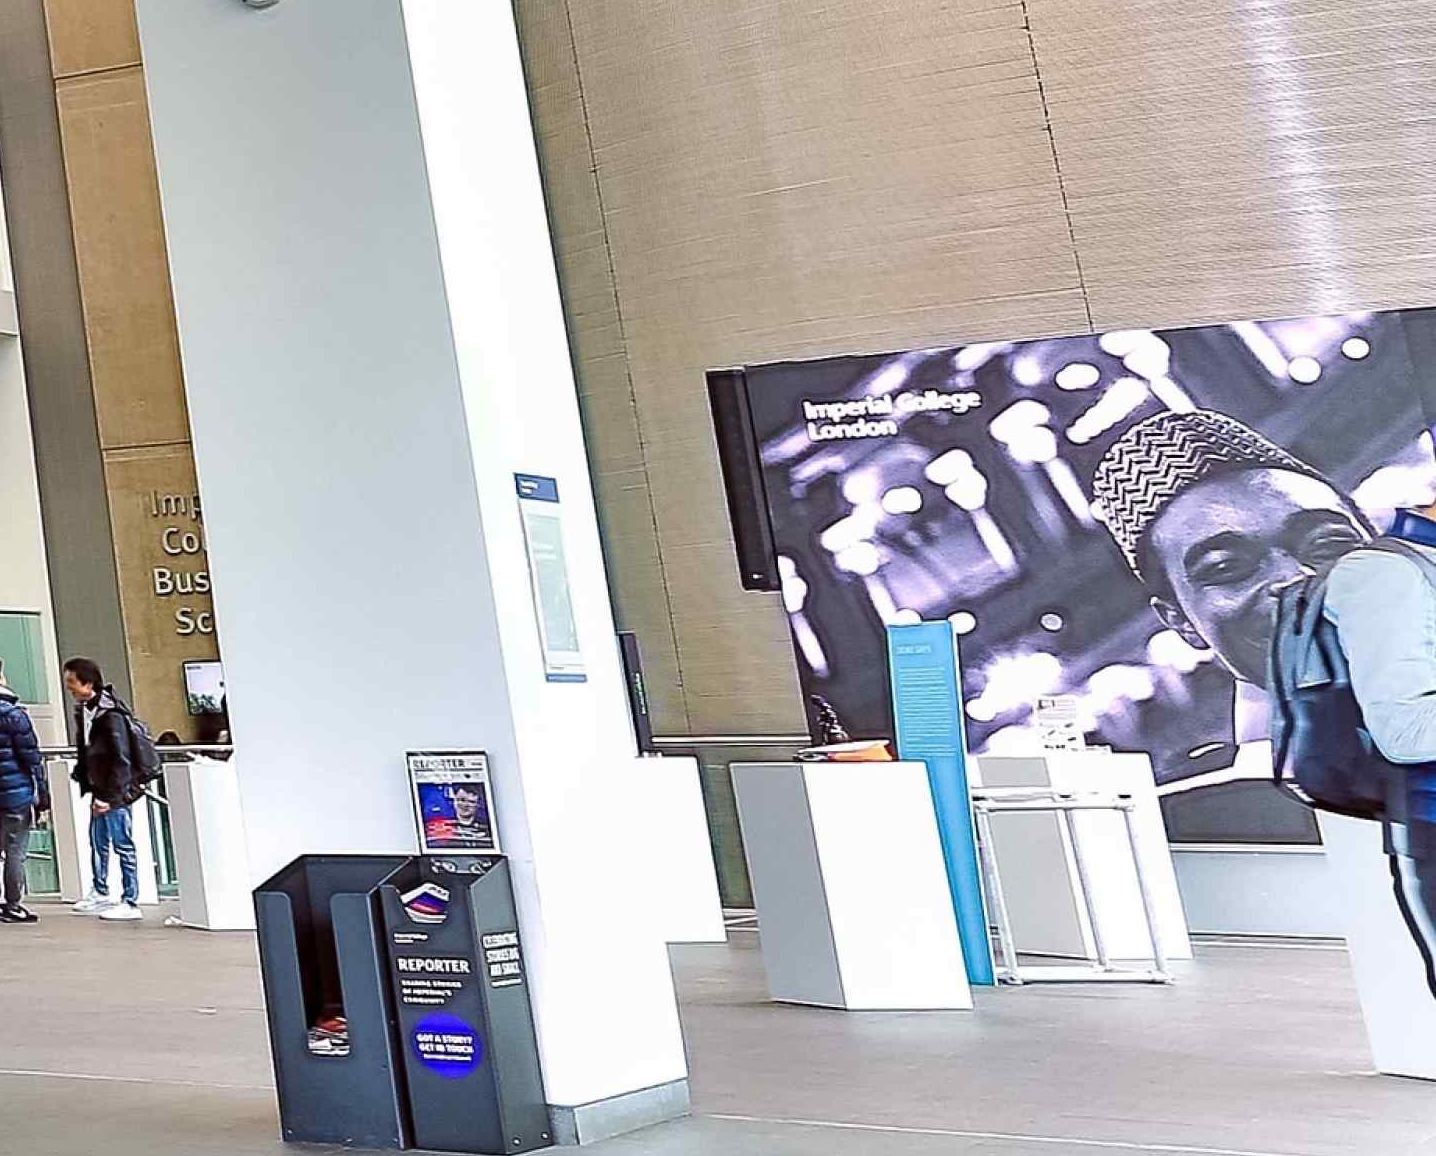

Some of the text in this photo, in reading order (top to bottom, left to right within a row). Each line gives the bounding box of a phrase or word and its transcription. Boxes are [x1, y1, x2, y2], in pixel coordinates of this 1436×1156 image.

[803, 394, 892, 422] Imperial
[807, 418, 898, 441] London
[397, 958, 470, 973] REPORTER
